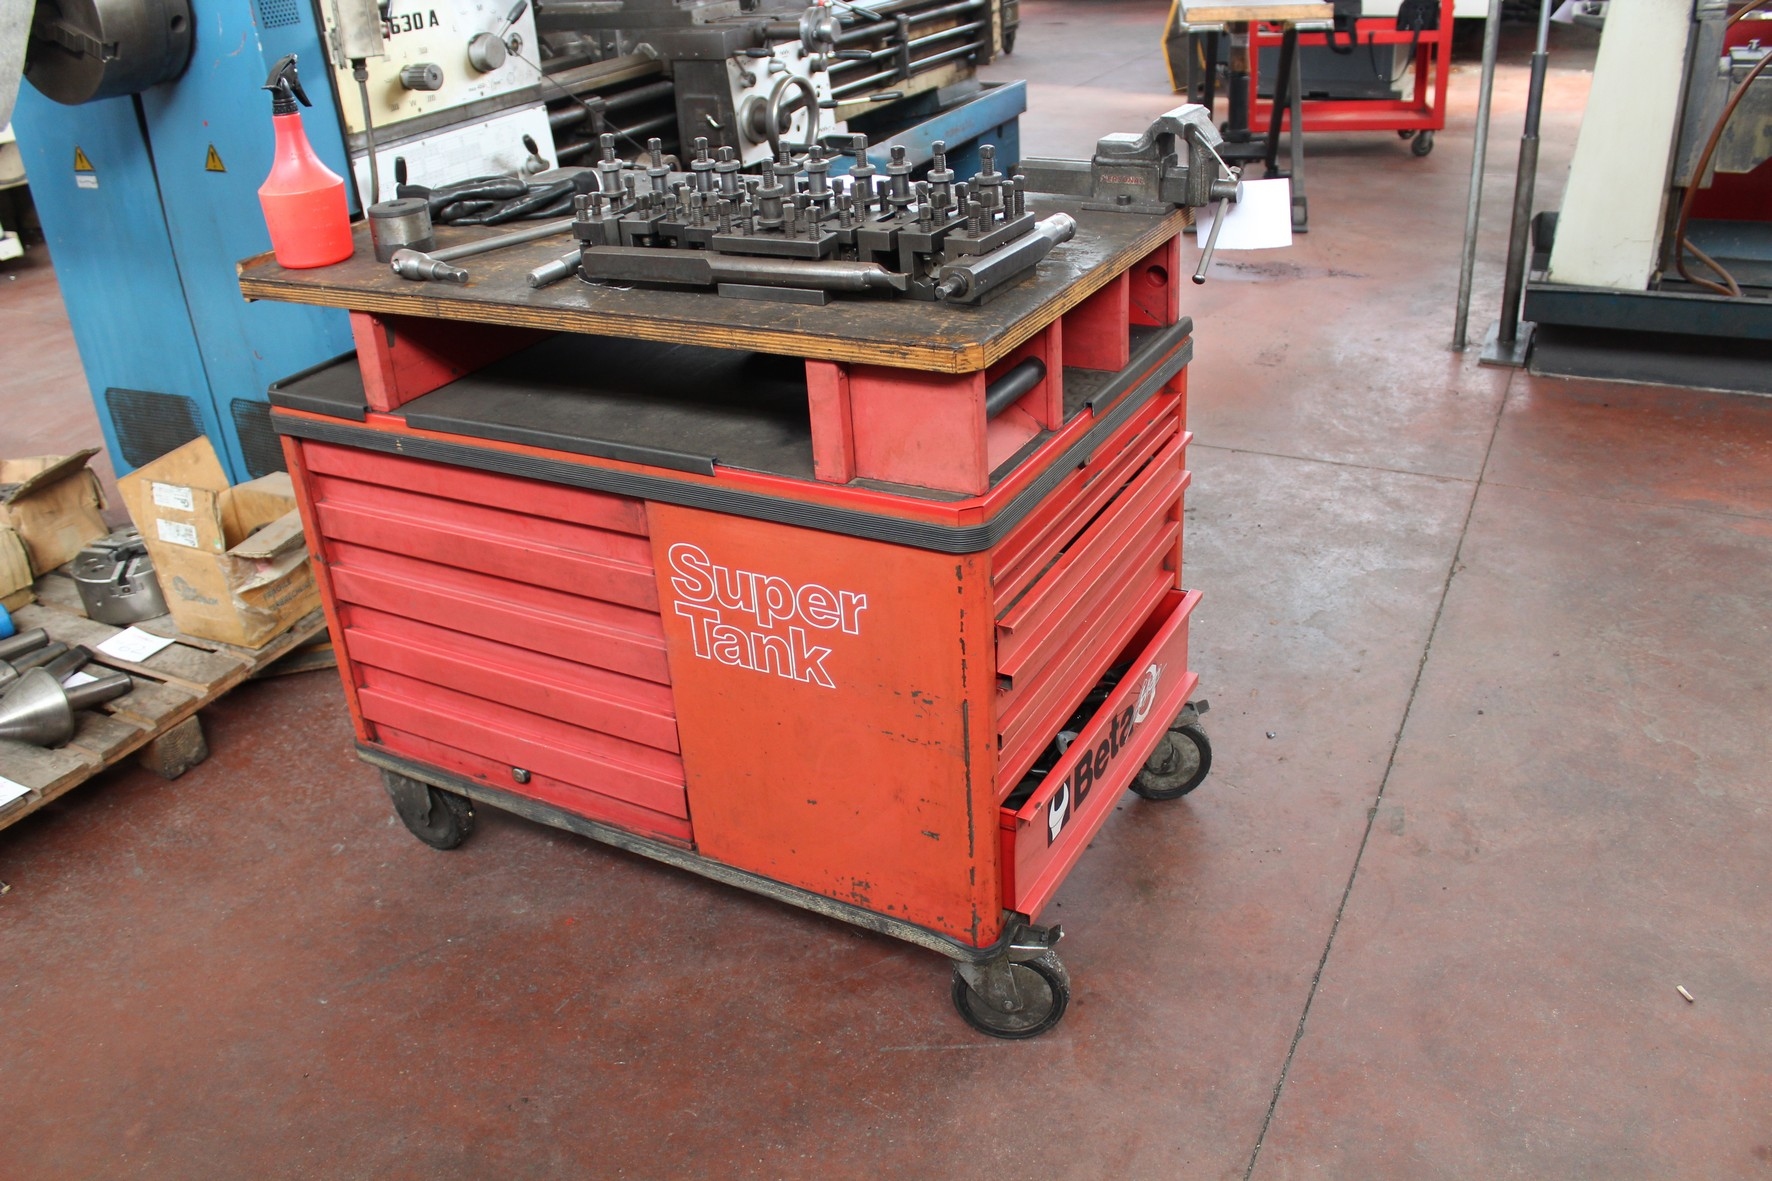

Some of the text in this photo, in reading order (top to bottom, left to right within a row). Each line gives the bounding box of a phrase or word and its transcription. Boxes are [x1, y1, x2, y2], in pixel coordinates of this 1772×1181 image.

[390, 9, 440, 35] 630 A
[668, 542, 868, 636] Super
[673, 600, 837, 689] Tank
[1073, 703, 1135, 813] Beta
